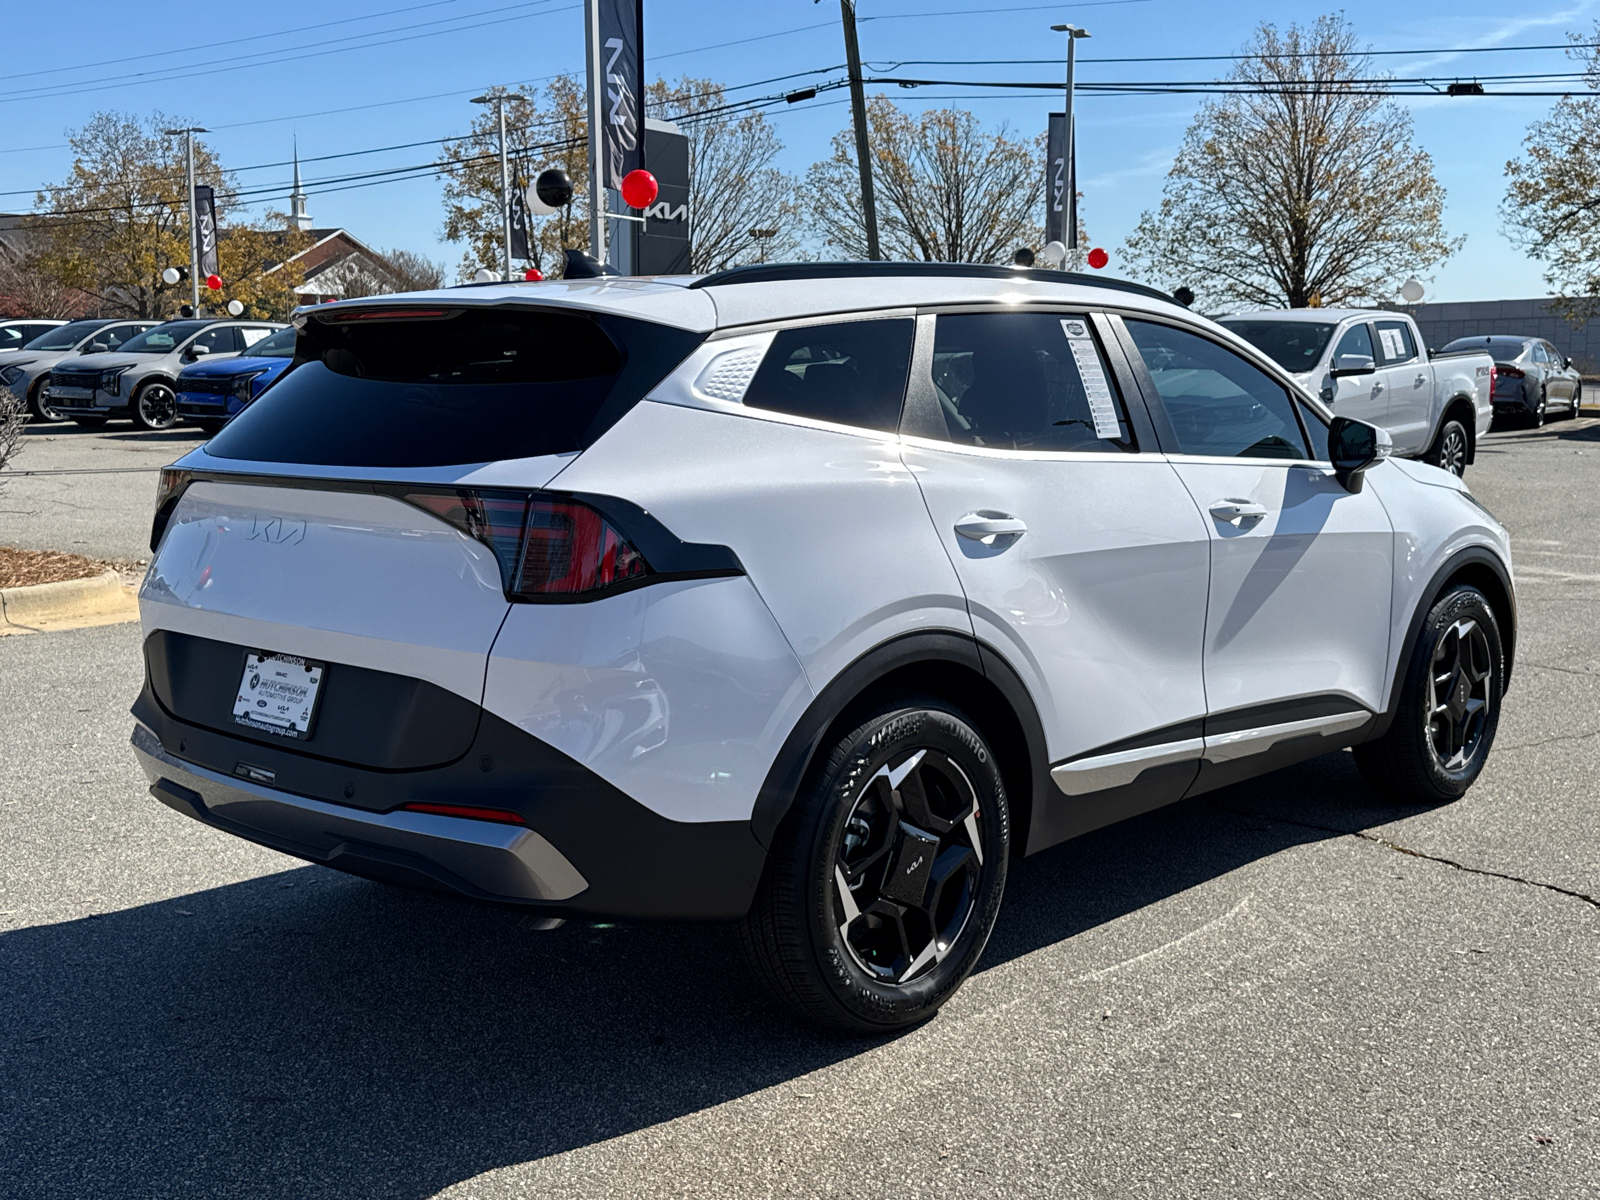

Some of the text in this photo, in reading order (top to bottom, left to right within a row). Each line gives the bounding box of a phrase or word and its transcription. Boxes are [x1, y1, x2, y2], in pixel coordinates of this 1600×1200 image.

[644, 201, 687, 221] KIA
[245, 515, 307, 546] KIA
[258, 689, 286, 702] AUTOMOTIVE
[286, 695, 304, 704] GROUP
[940, 719, 987, 763] KUMHO
[906, 855, 923, 875] KIA
